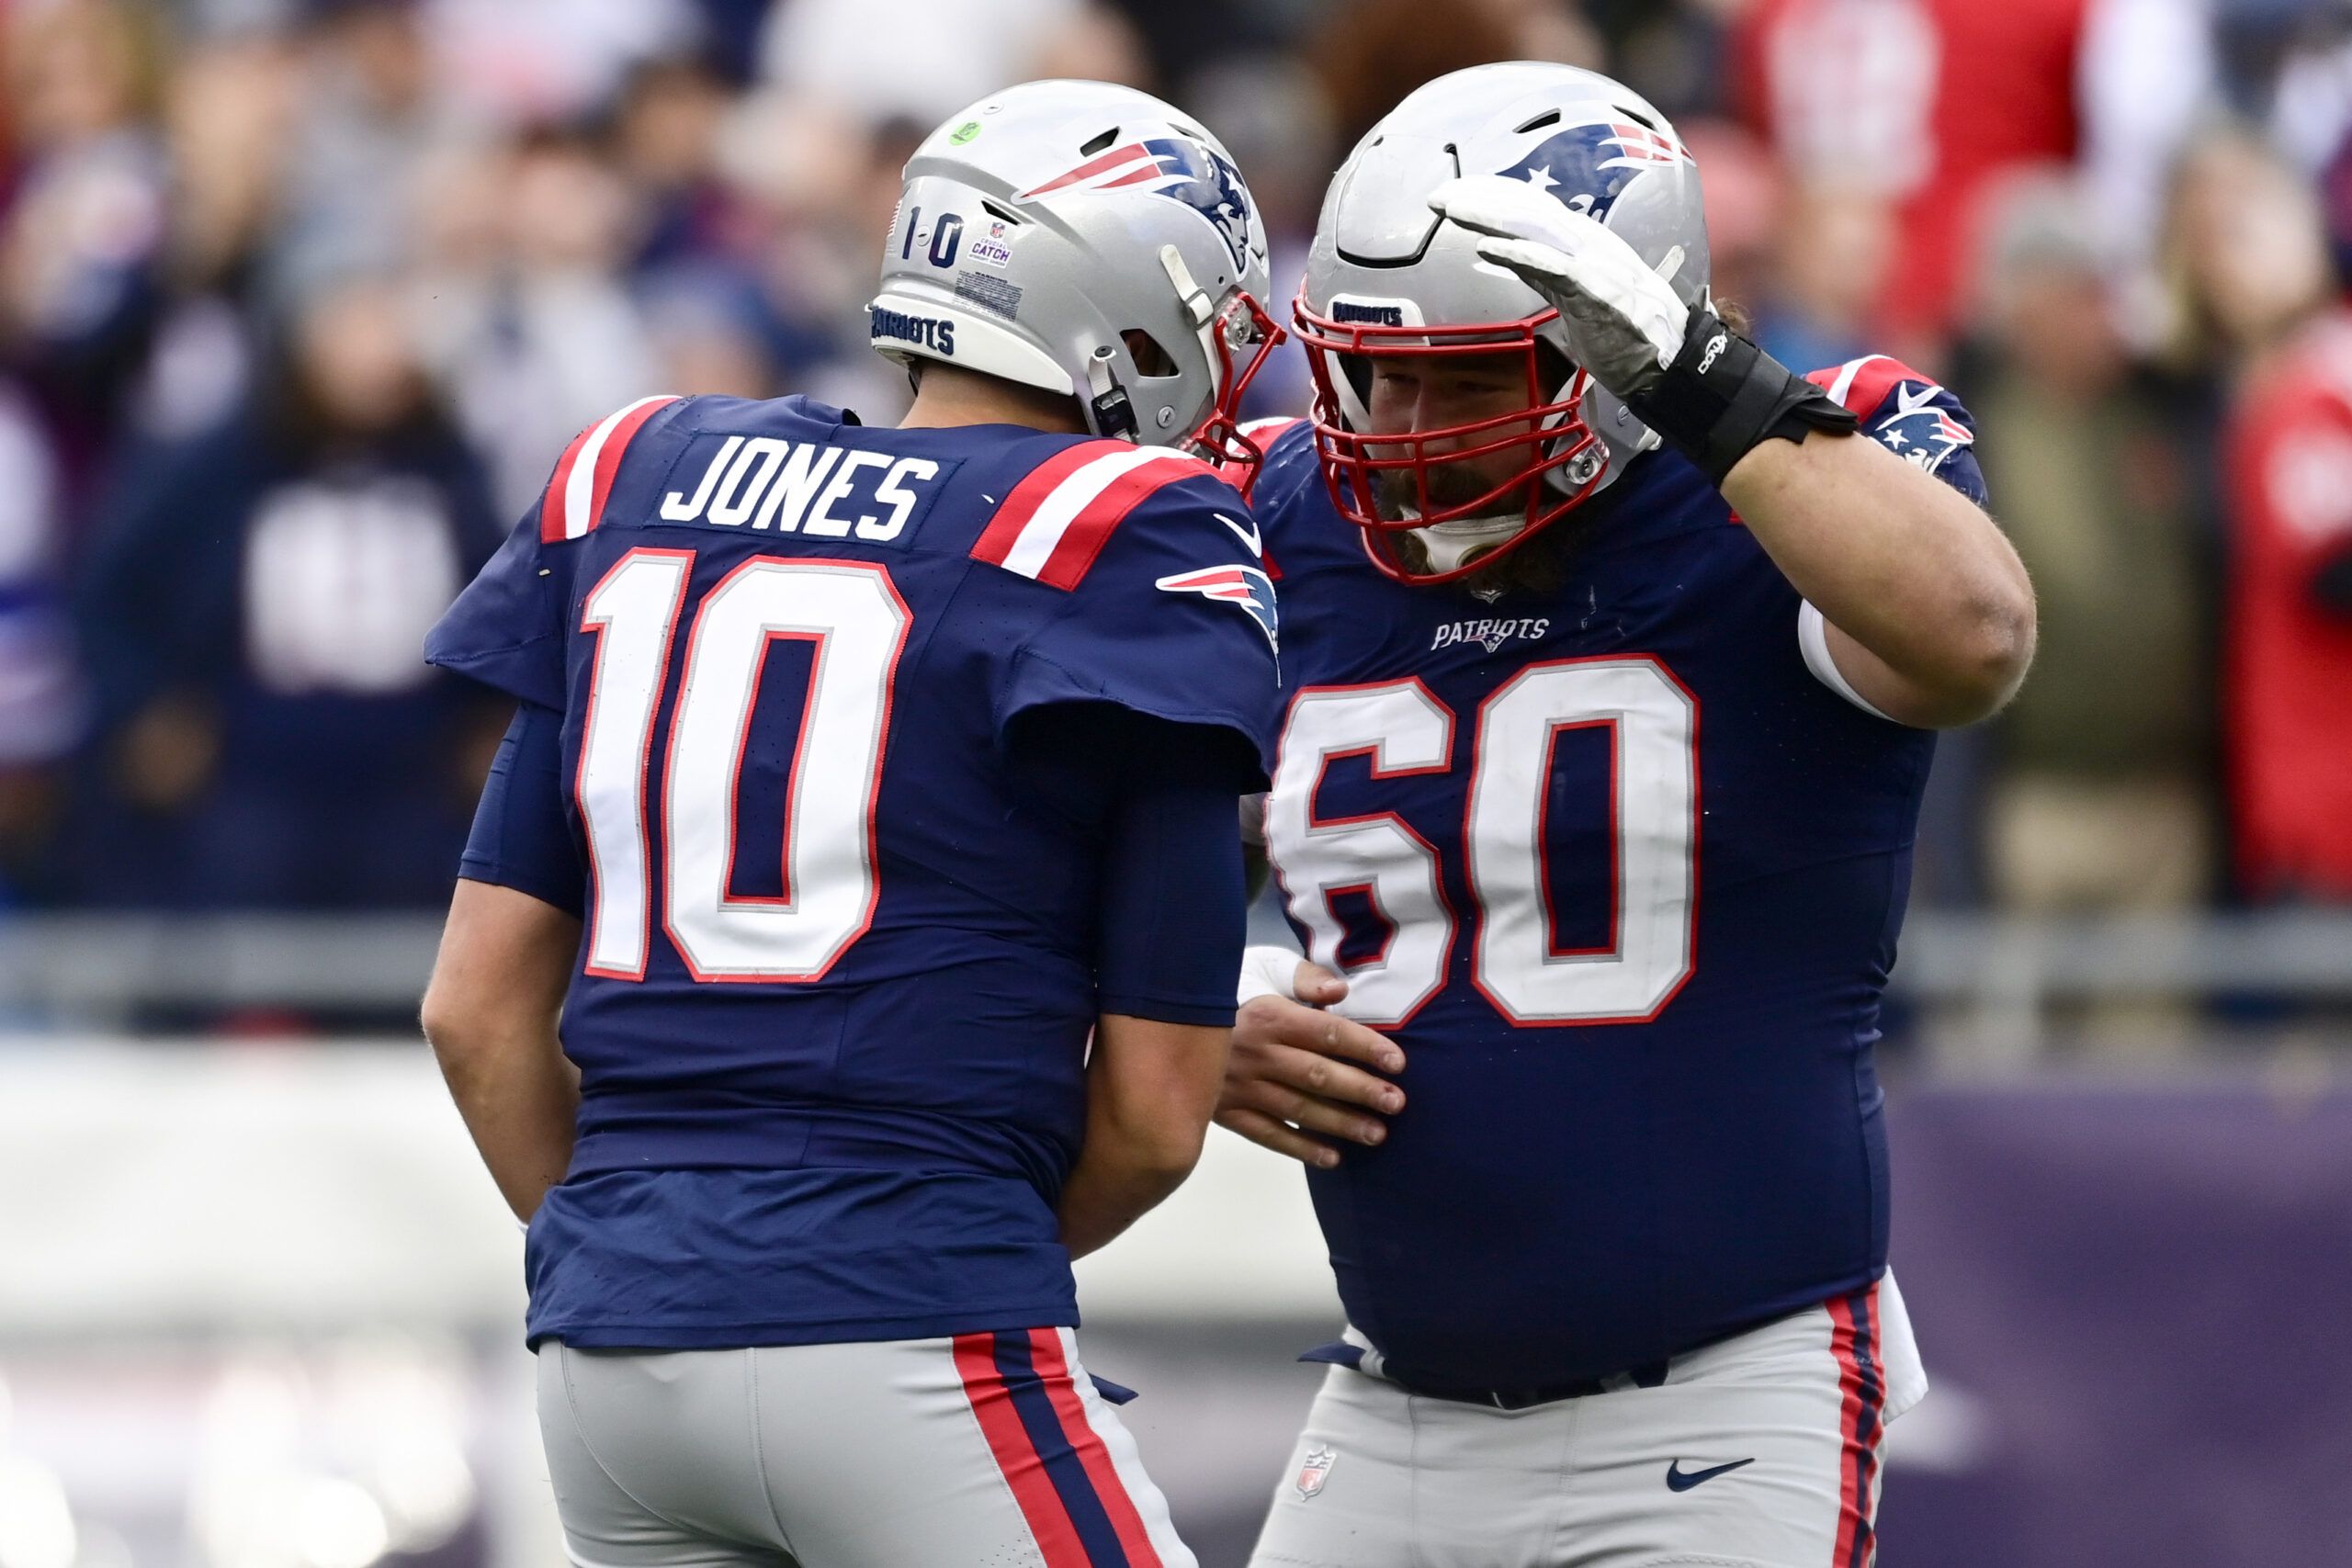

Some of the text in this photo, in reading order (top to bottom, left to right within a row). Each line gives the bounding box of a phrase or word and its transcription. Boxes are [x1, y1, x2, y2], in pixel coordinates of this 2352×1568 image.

[902, 206, 965, 268] 10
[972, 243, 1011, 262] CATCH
[660, 435, 939, 541] JONES
[1430, 618, 1550, 651] PATRIOTS
[575, 547, 913, 983] 10
[1262, 653, 1701, 1030] 60
